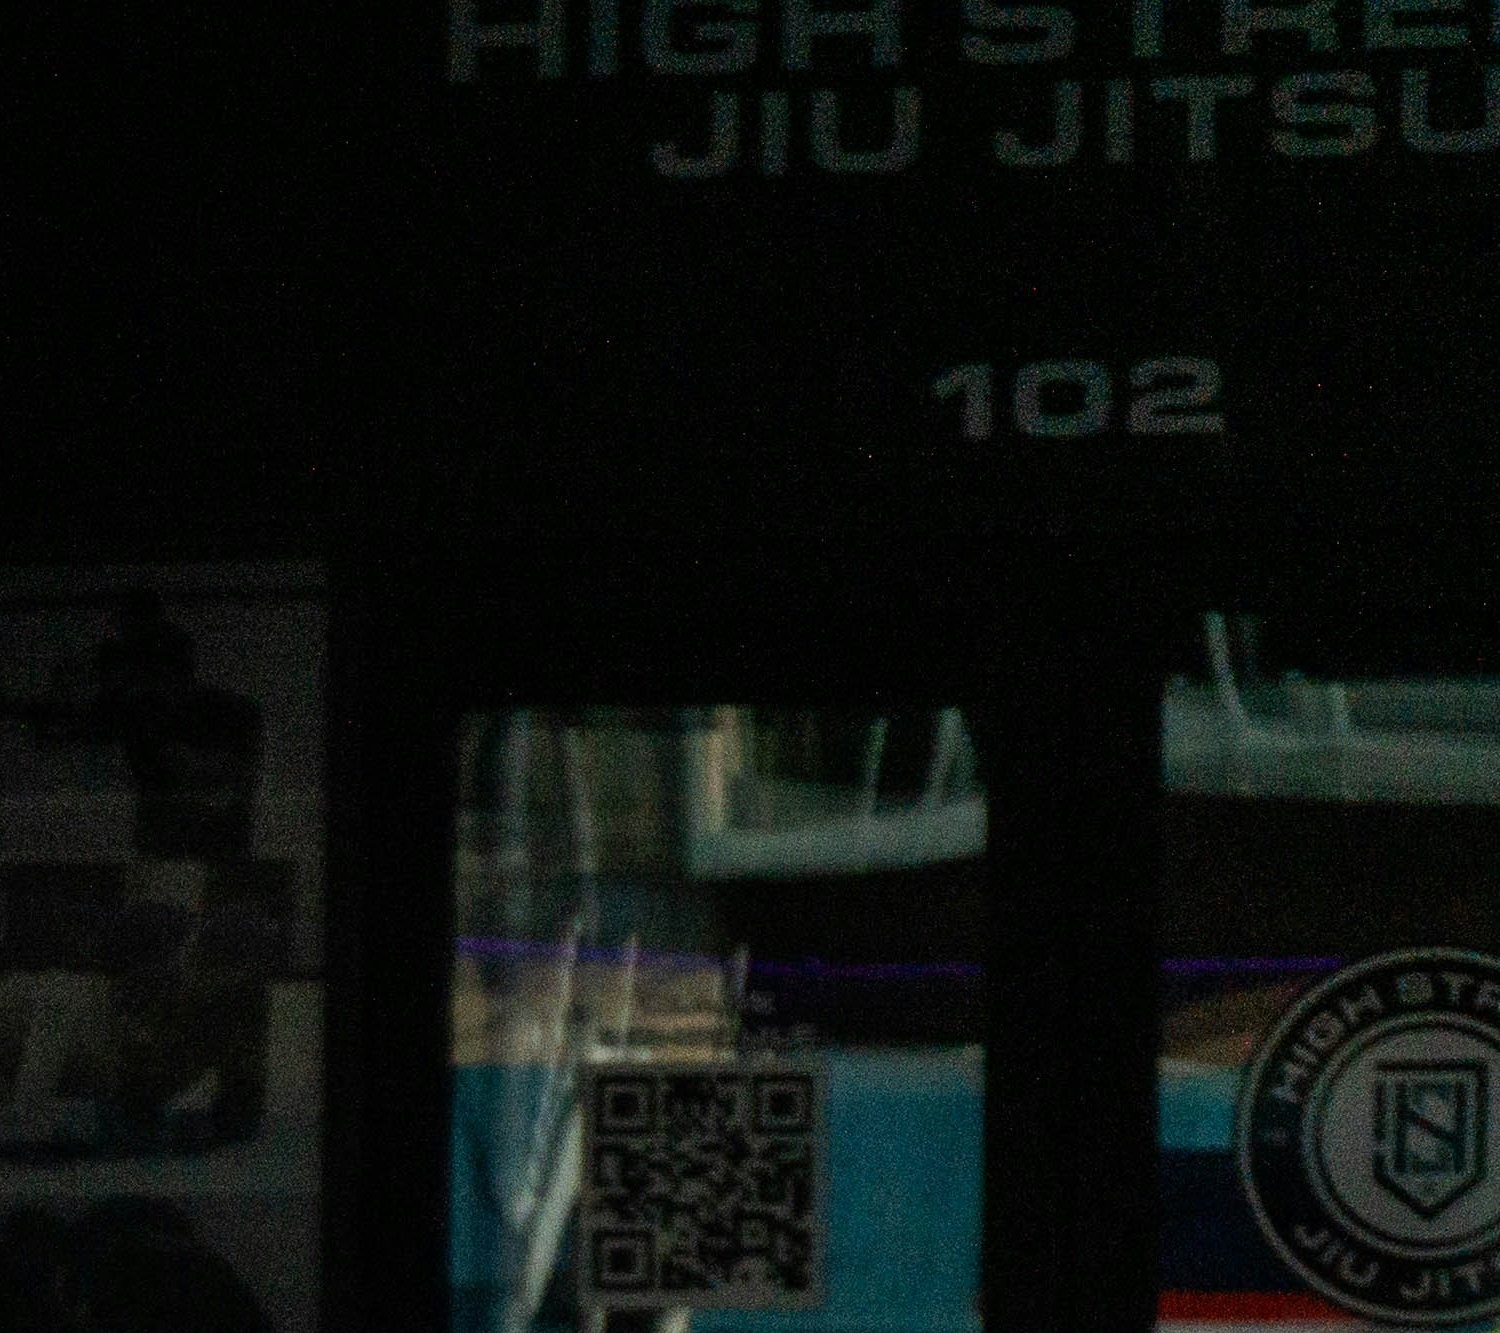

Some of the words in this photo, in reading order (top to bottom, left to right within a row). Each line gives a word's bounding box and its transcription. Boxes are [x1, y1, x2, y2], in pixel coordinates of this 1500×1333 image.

[446, 0, 902, 82] HIGH
[961, 0, 1500, 63] STRE
[648, 87, 921, 179] JIU
[993, 68, 1500, 166] JITSU
[932, 356, 1226, 440] 102
